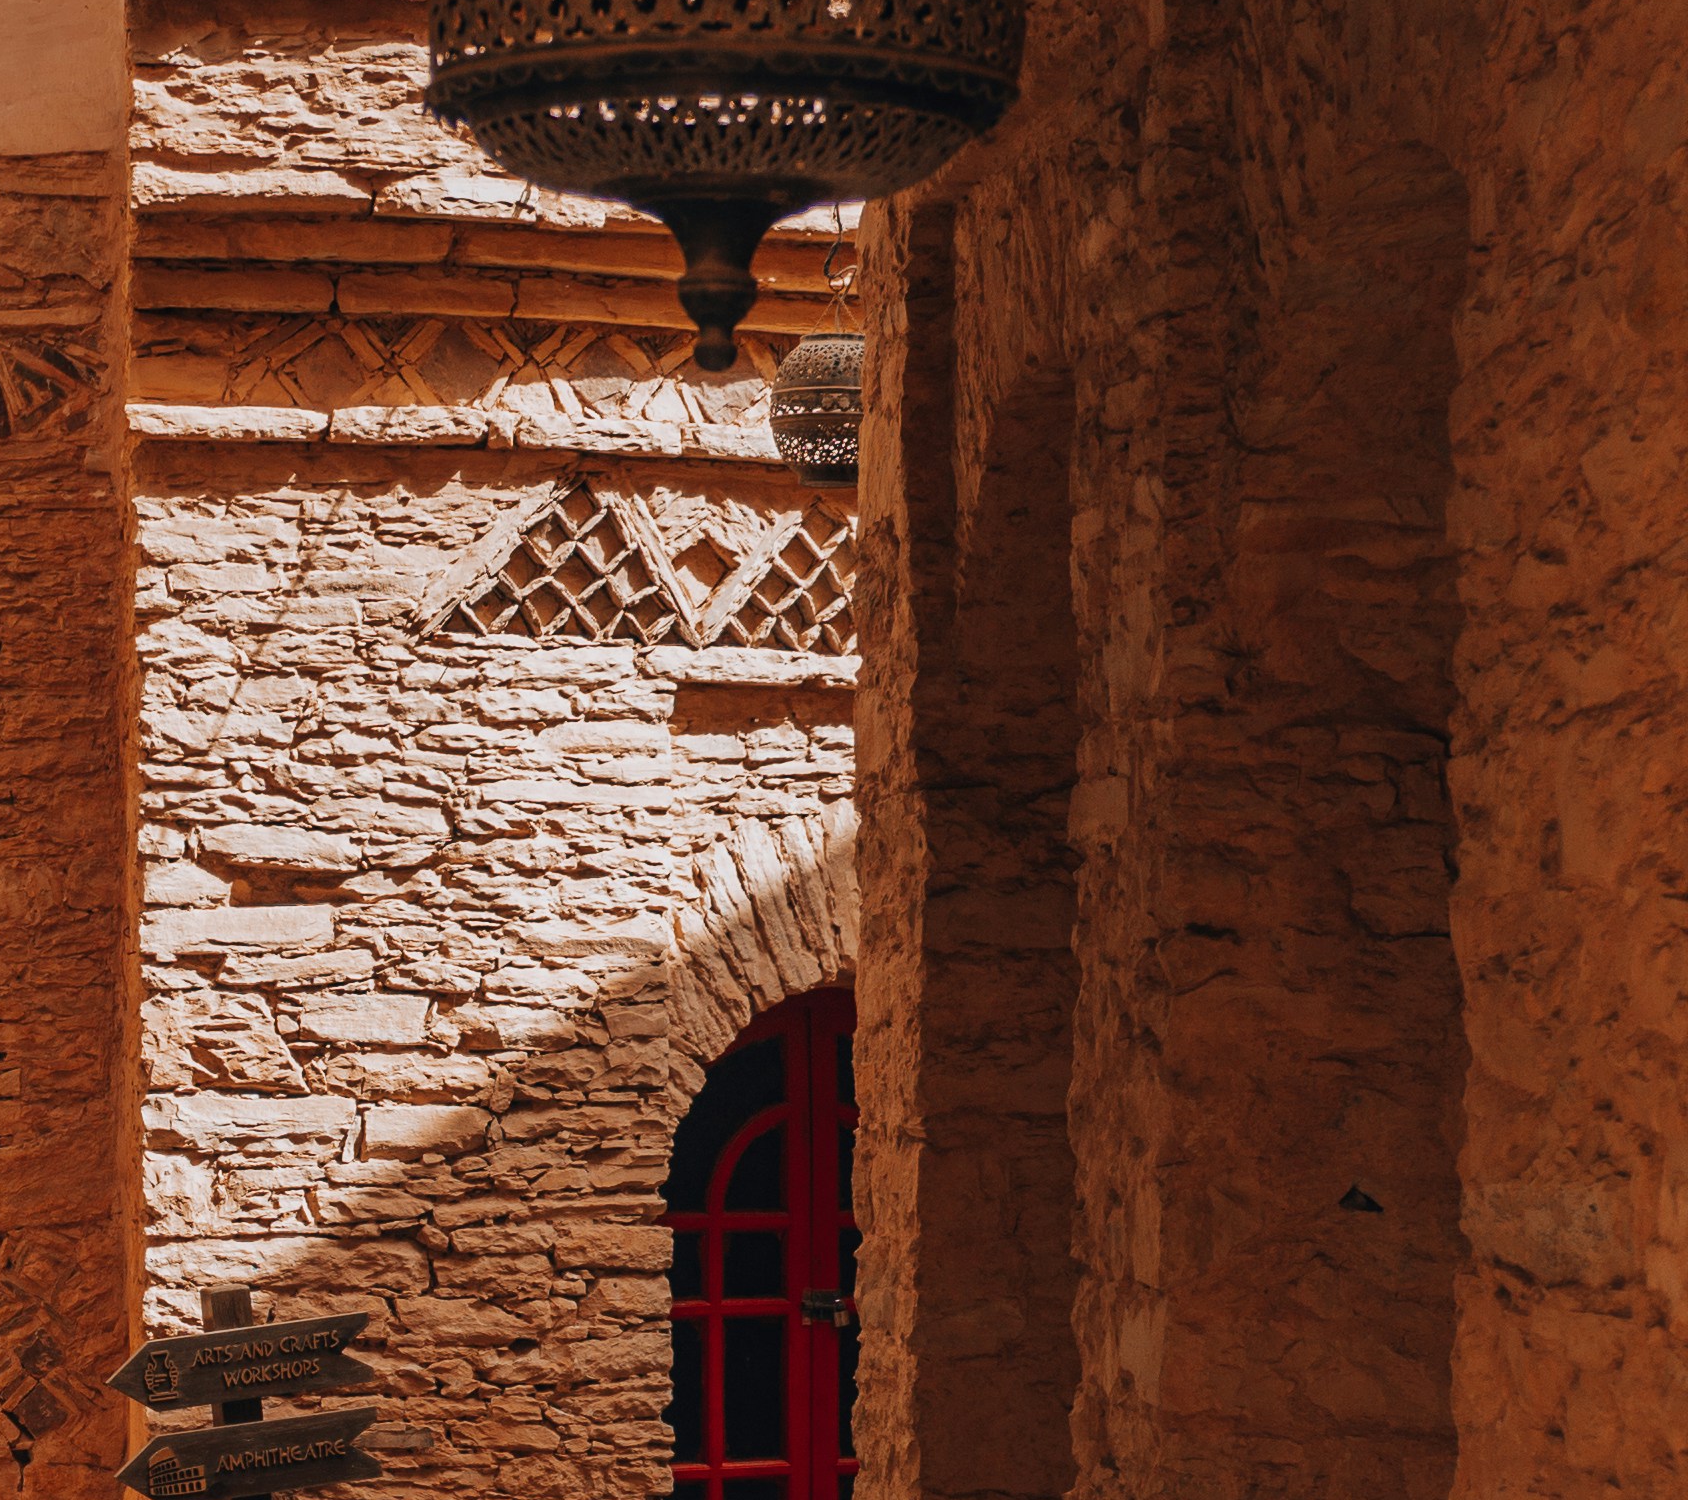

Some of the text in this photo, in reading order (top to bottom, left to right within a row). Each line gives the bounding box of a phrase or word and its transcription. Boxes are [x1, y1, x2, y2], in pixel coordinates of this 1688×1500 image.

[190, 1329, 340, 1368] ARTS AND CRAFTS
[223, 1358, 321, 1387] WORKSHOPS
[215, 1438, 346, 1473] AMPHITHEATRE
